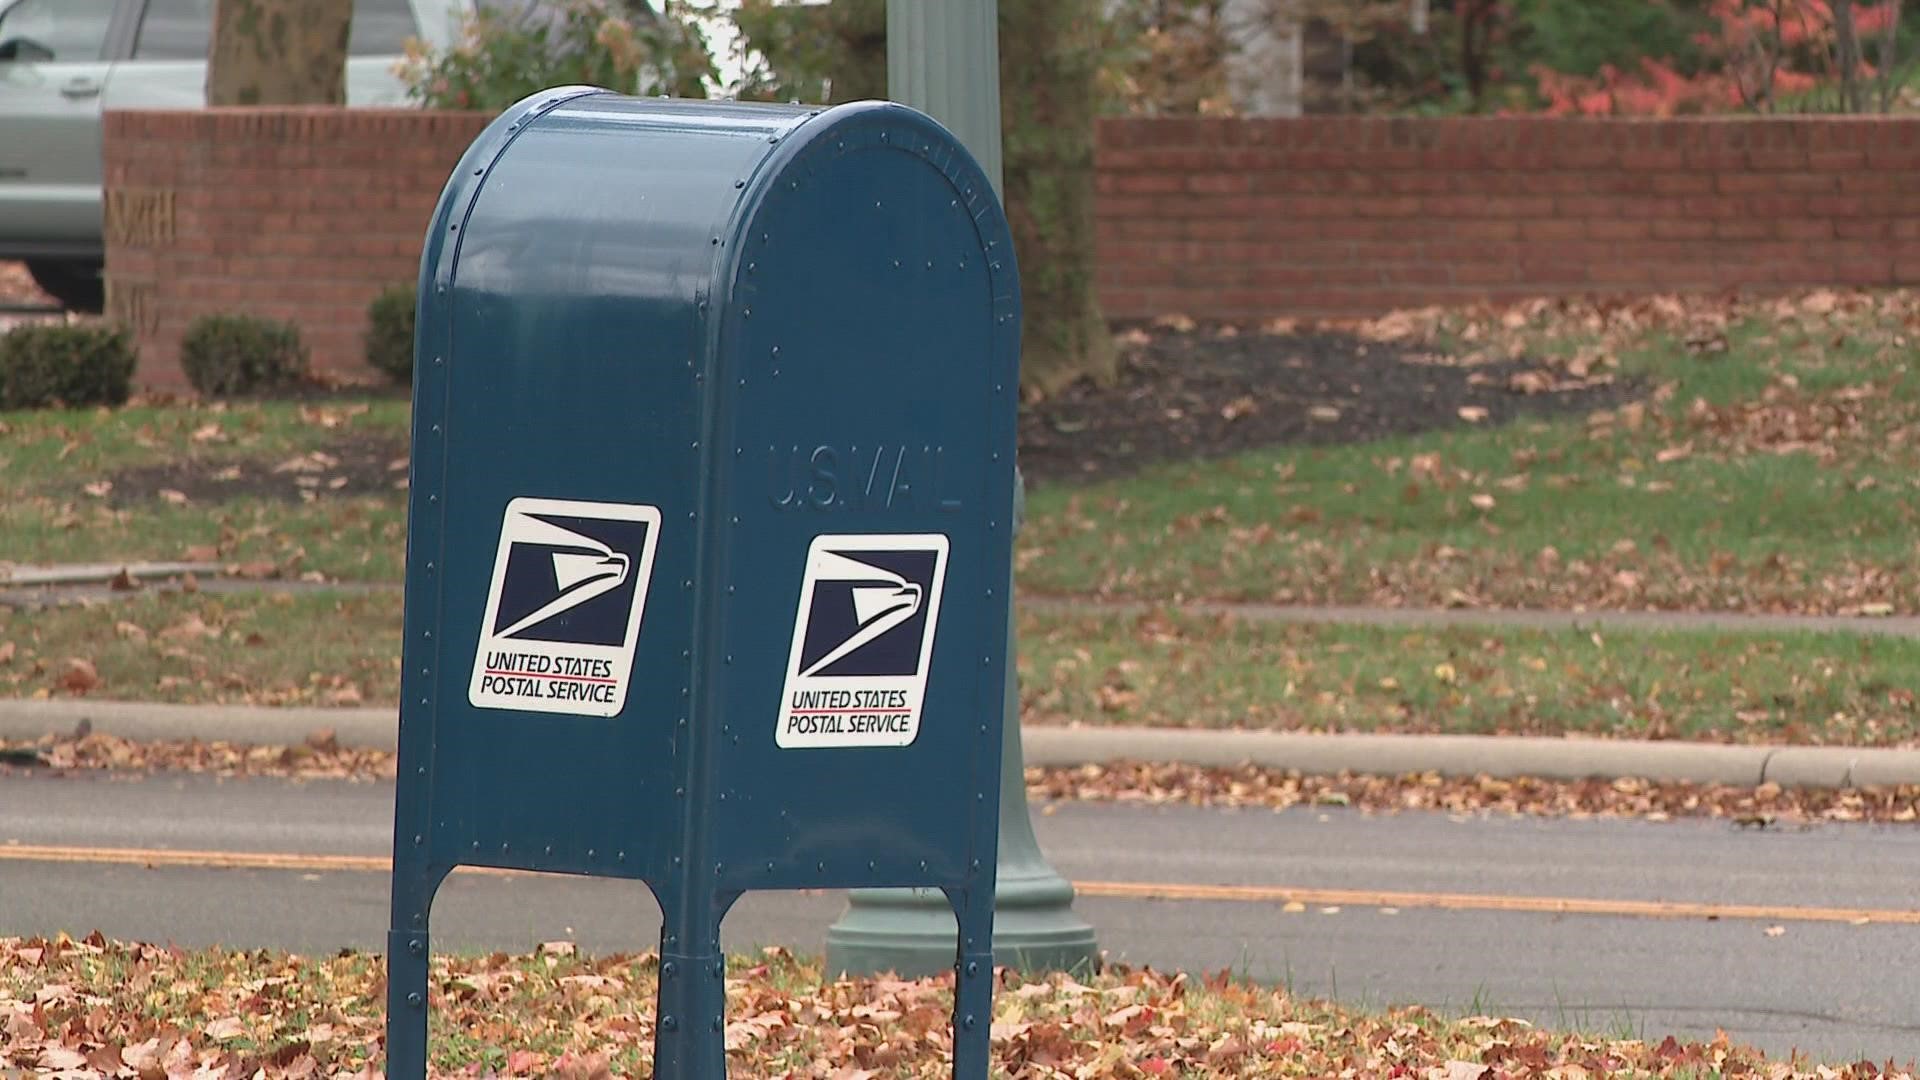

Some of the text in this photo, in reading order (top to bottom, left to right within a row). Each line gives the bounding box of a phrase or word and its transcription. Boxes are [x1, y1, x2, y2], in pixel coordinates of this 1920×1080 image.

[486, 651, 613, 678] UNITED STATES
[481, 675, 617, 703] POSTAL SERVICE
[792, 690, 907, 709] UNITED STATES
[787, 714, 911, 734] POSTAL SERVICE
